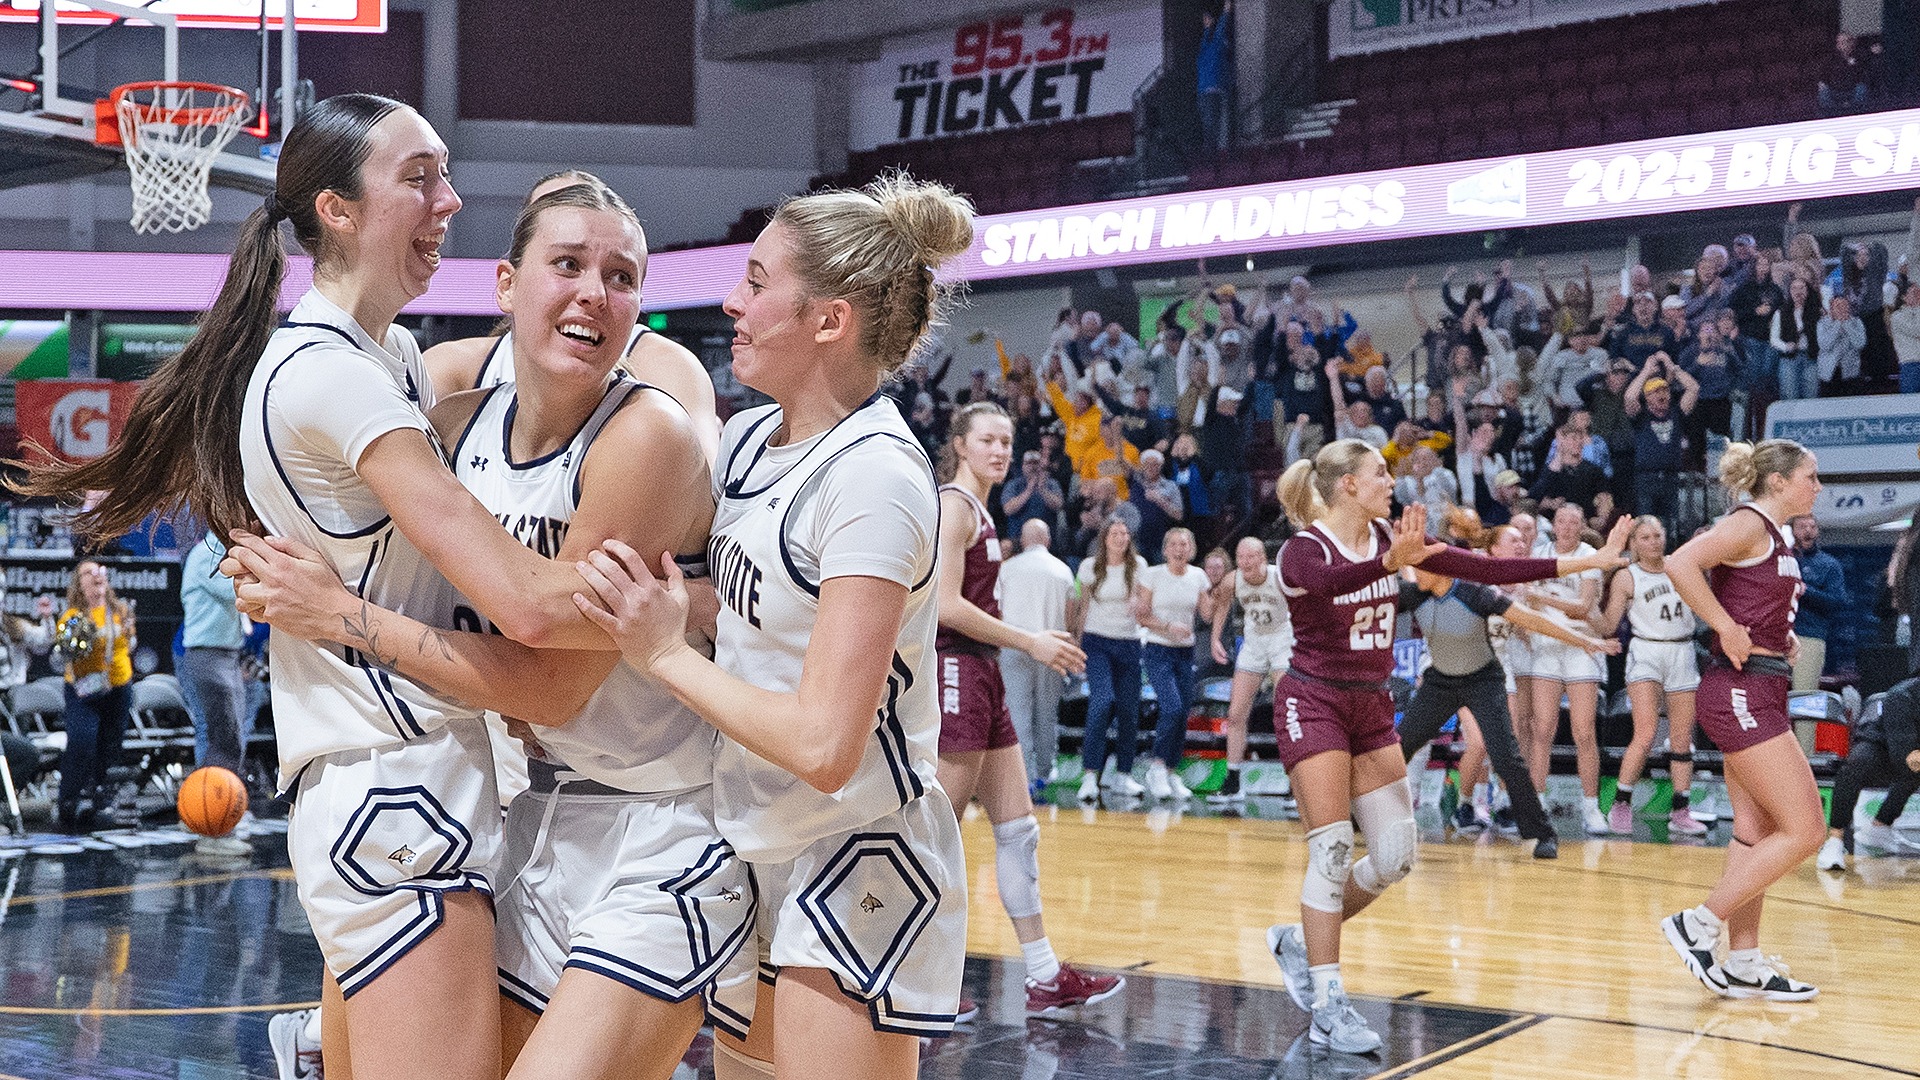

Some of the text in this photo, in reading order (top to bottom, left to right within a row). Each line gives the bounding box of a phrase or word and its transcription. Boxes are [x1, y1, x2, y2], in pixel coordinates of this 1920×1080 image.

[901, 60, 939, 82] THE
[951, 8, 1075, 75] 95.3
[894, 57, 1105, 138] TICKET
[1563, 147, 1715, 207] 2025
[1725, 134, 1838, 191] BIG
[982, 181, 1405, 267] STARCH MADNESS
[51, 389, 110, 456] G
[1250, 608, 1273, 626] 23
[1350, 602, 1395, 651] 23
[1660, 602, 1684, 621] 44
